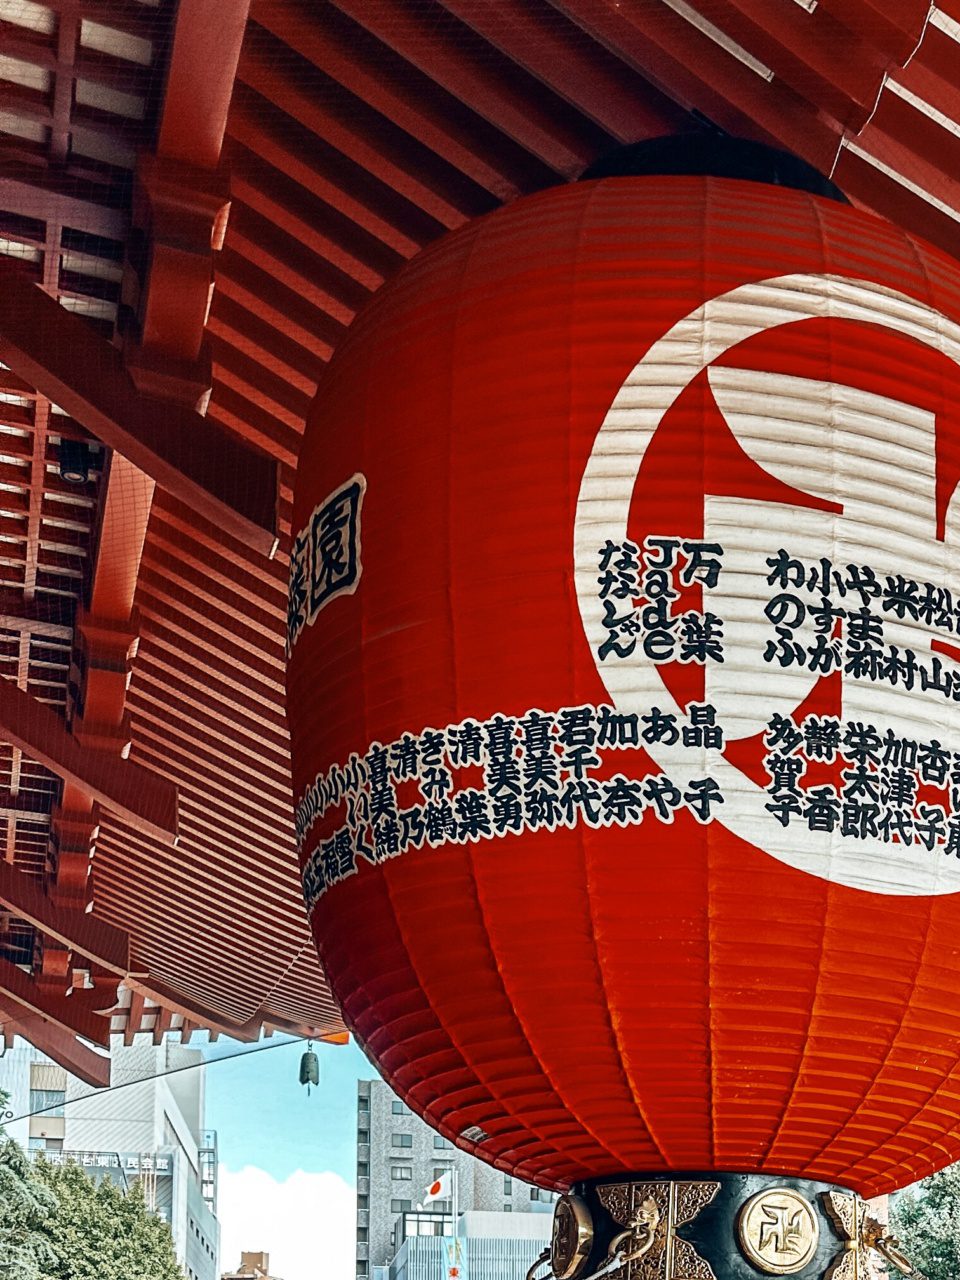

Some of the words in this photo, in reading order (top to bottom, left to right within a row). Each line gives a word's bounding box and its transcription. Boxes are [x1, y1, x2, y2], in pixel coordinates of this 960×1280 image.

[598, 541, 640, 661] ななしゃん
[643, 539, 681, 660] Jade
[681, 541, 724, 662] 万葉
[763, 549, 806, 667] わのふ
[806, 558, 846, 673] 小すが
[882, 575, 919, 691] 米村
[919, 582, 954, 698] 松山
[365, 745, 400, 861] 喜美緒
[391, 735, 425, 848] 清乃
[419, 731, 458, 843] きみ鶴
[448, 722, 491, 841] 清葉
[484, 716, 523, 832] 喜美勇
[519, 712, 559, 827] 喜美弥
[558, 707, 601, 824] 君千代
[597, 706, 642, 820] 加奈
[641, 707, 682, 820] あや
[681, 704, 724, 821] 晶子
[764, 713, 804, 827] 多賀子
[803, 717, 842, 832] 静香
[840, 722, 882, 840] 栄太郎
[878, 729, 917, 846] 加津代
[914, 740, 951, 851] 杏子
